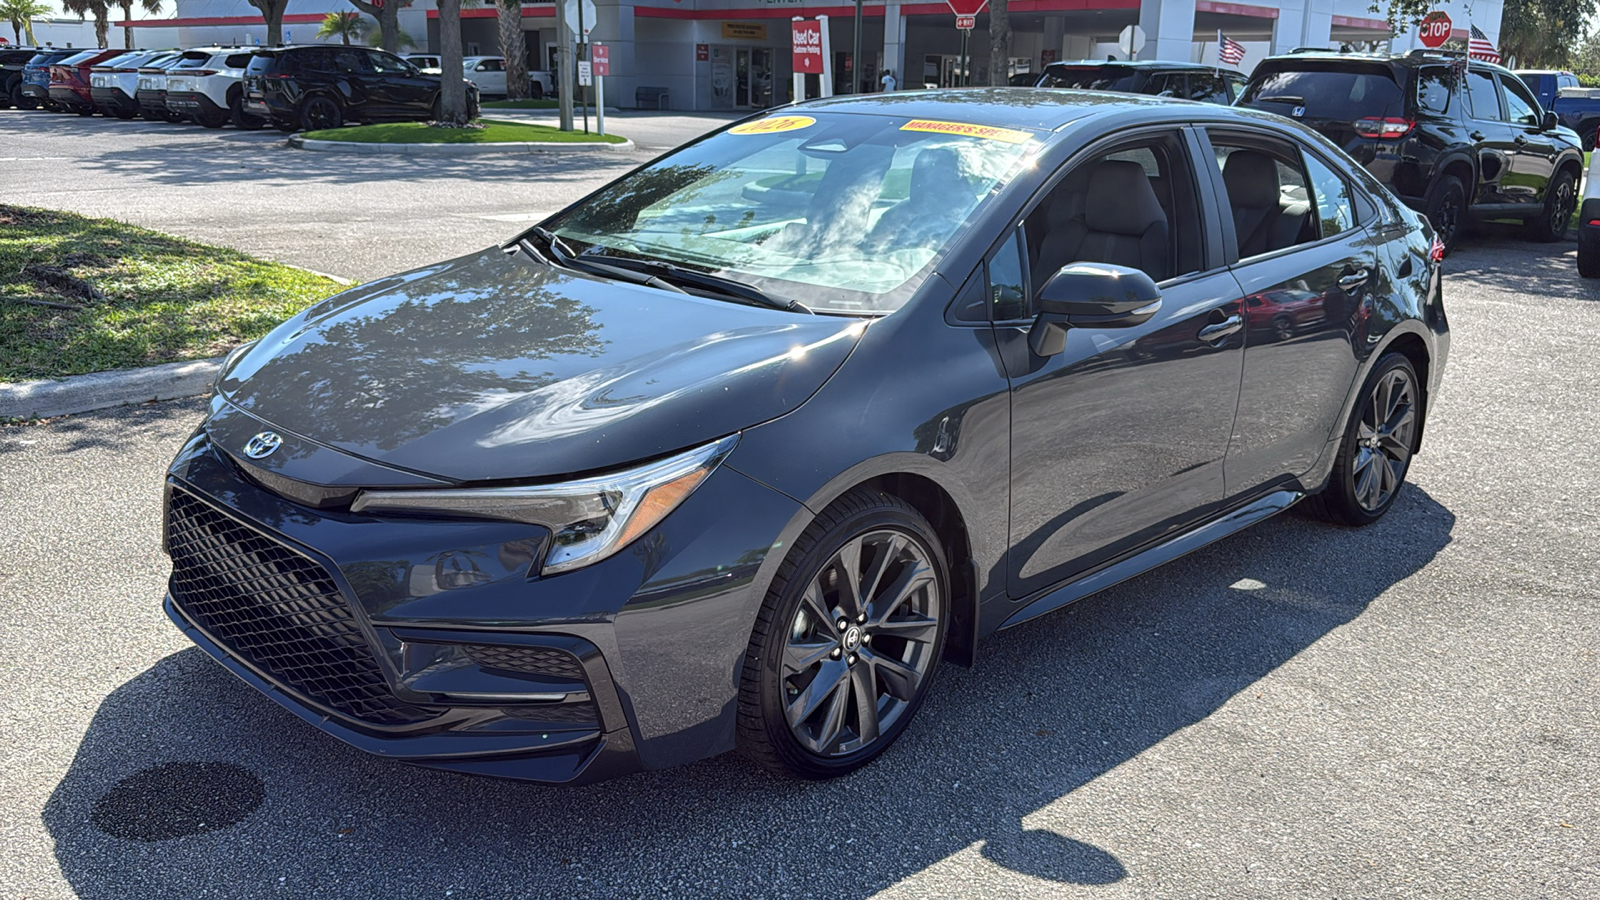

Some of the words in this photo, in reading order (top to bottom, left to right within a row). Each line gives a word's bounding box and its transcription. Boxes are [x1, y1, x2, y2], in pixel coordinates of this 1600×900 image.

[957, 19, 974, 27] 4-WAY
[1421, 22, 1450, 37] STOP
[793, 30, 807, 45] Used
[808, 29, 820, 45] Car
[807, 45, 820, 55] Parking
[903, 121, 977, 134] MANAGER'S
